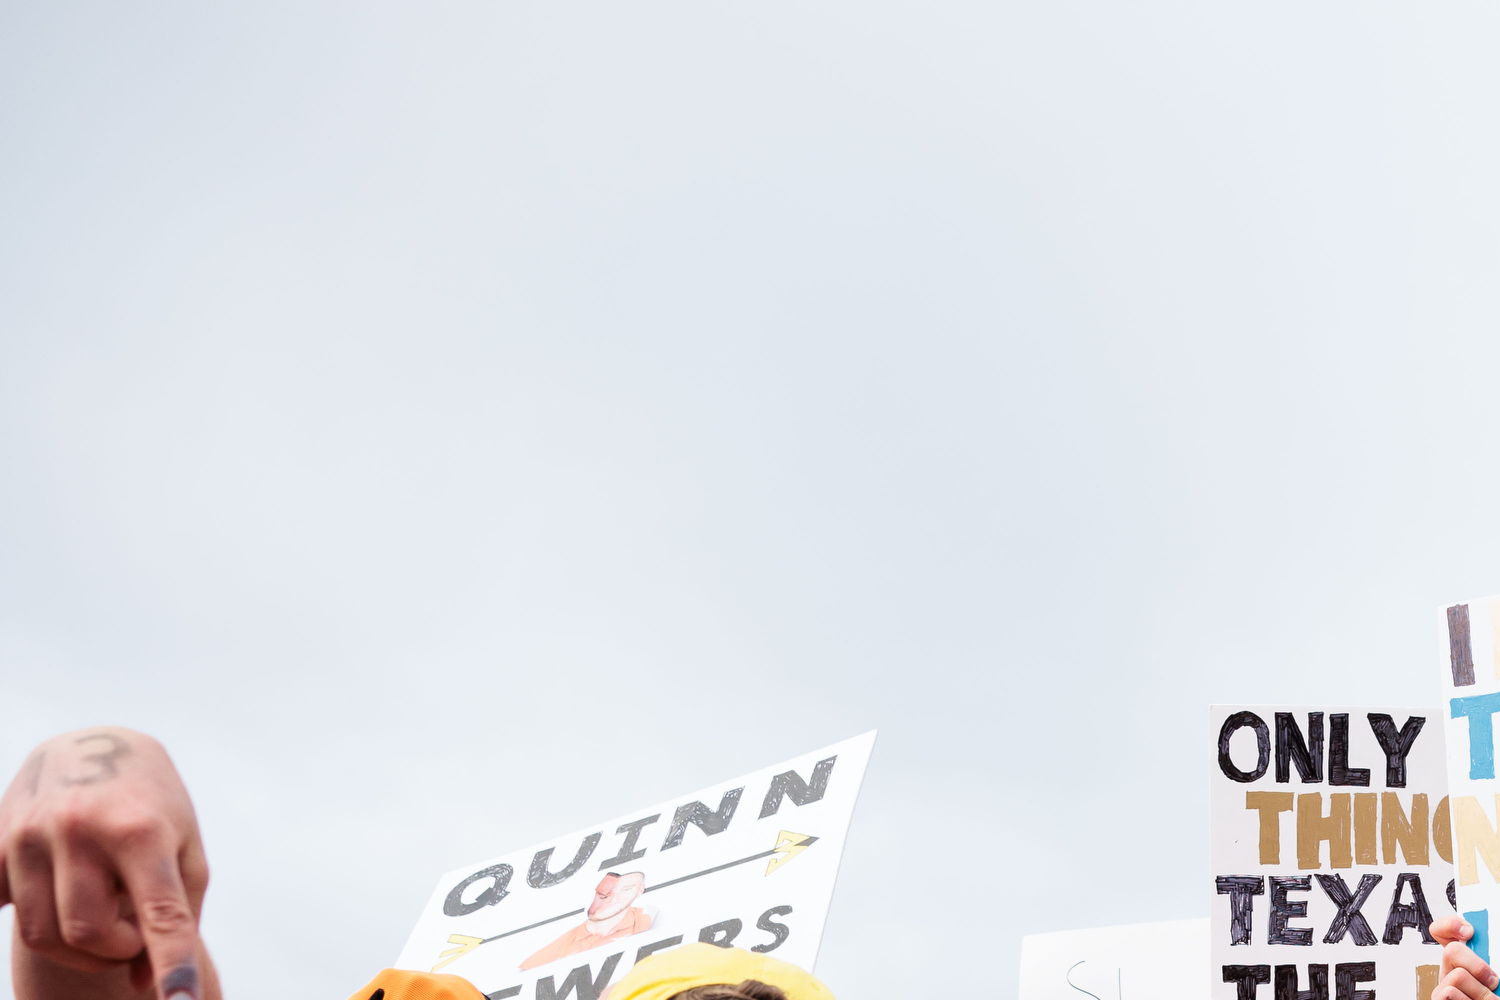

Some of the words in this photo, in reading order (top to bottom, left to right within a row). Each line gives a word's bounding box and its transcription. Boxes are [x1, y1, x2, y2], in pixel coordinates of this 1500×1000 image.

[1447, 604, 1475, 687] I
[1217, 712, 1426, 788] ONLY
[443, 755, 838, 918] QUINN
[1215, 873, 1457, 946] TEXA
